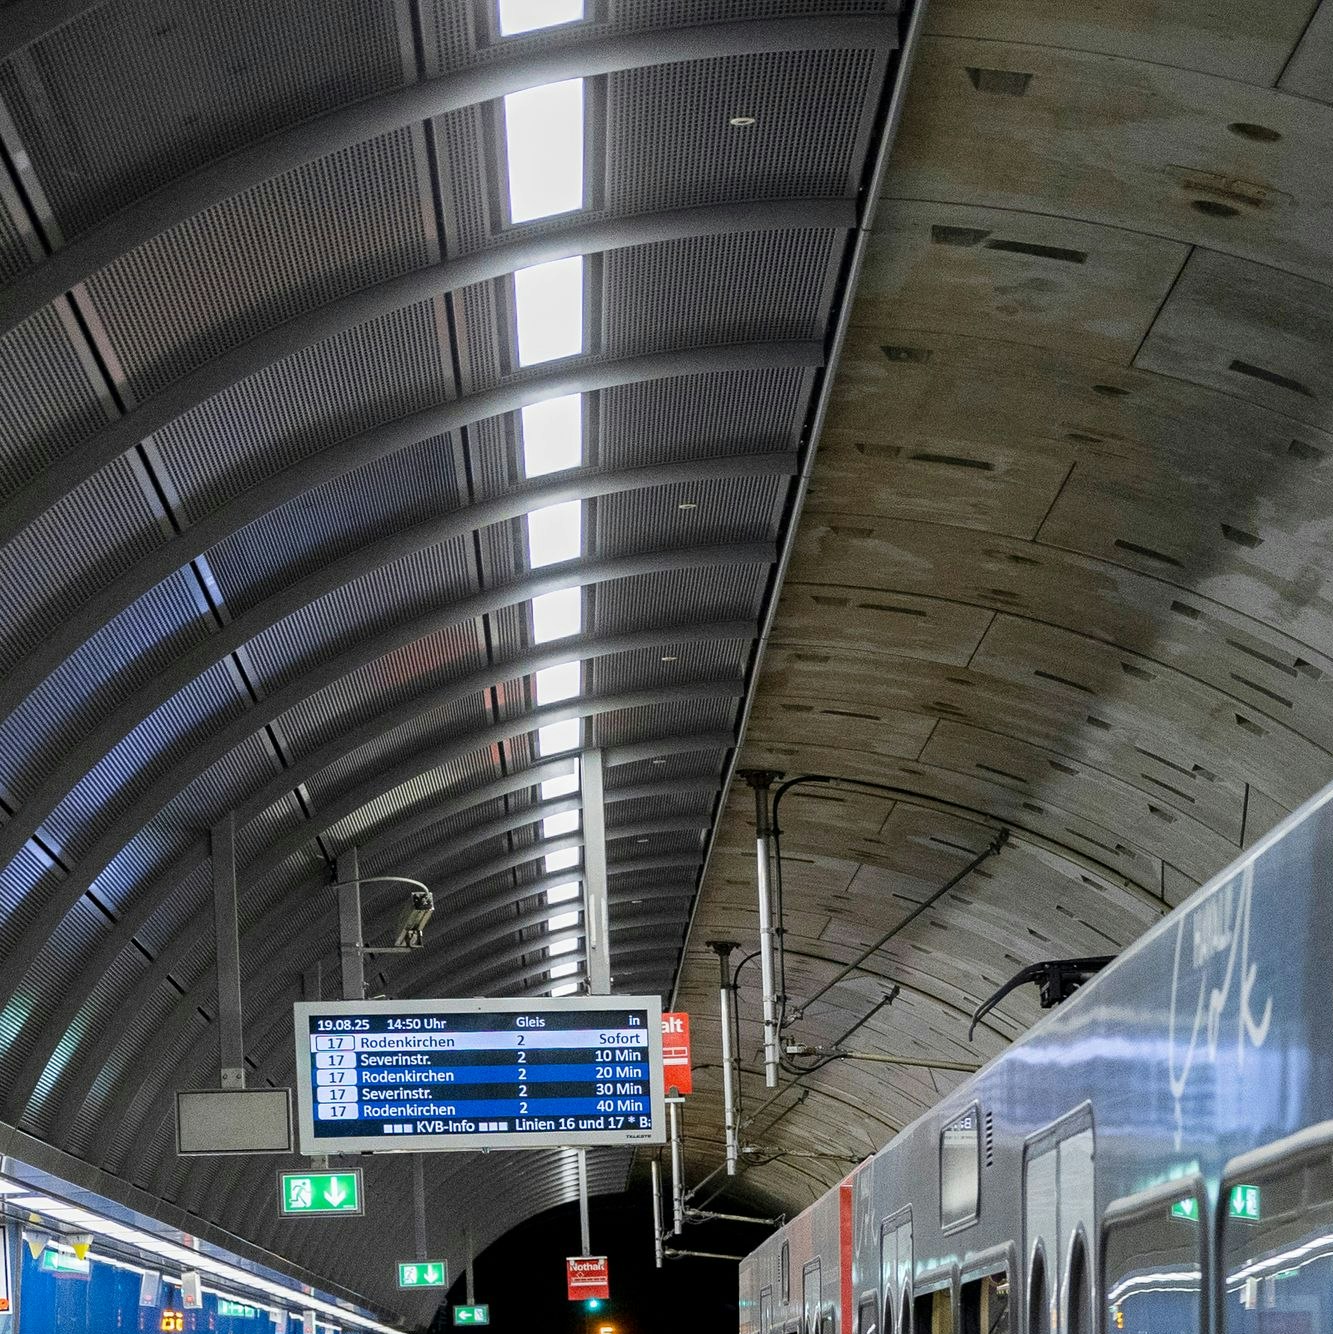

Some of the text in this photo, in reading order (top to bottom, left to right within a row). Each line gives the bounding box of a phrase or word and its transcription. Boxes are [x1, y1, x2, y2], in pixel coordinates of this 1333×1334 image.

[317, 1015, 640, 1031] 19.08.25 14:50 Uhr Gleis in
[327, 1032, 641, 1049] 17 Rodenkirchen 2 Sofort
[328, 1049, 641, 1067] 17 Severinstr. 2 10 Min
[328, 1066, 642, 1083] 17 Rodenkirchen 2 20 Min
[329, 1082, 642, 1100] 17 Severinstr. 2 30 Min
[330, 1099, 643, 1117] 17 Rodenkirchen 2 40 Min
[417, 1120, 475, 1132] KVB-Info
[515, 1118, 555, 1130] Linien
[558, 1118, 575, 1129] 16
[578, 1117, 605, 1129] und
[608, 1117, 624, 1128] 17
